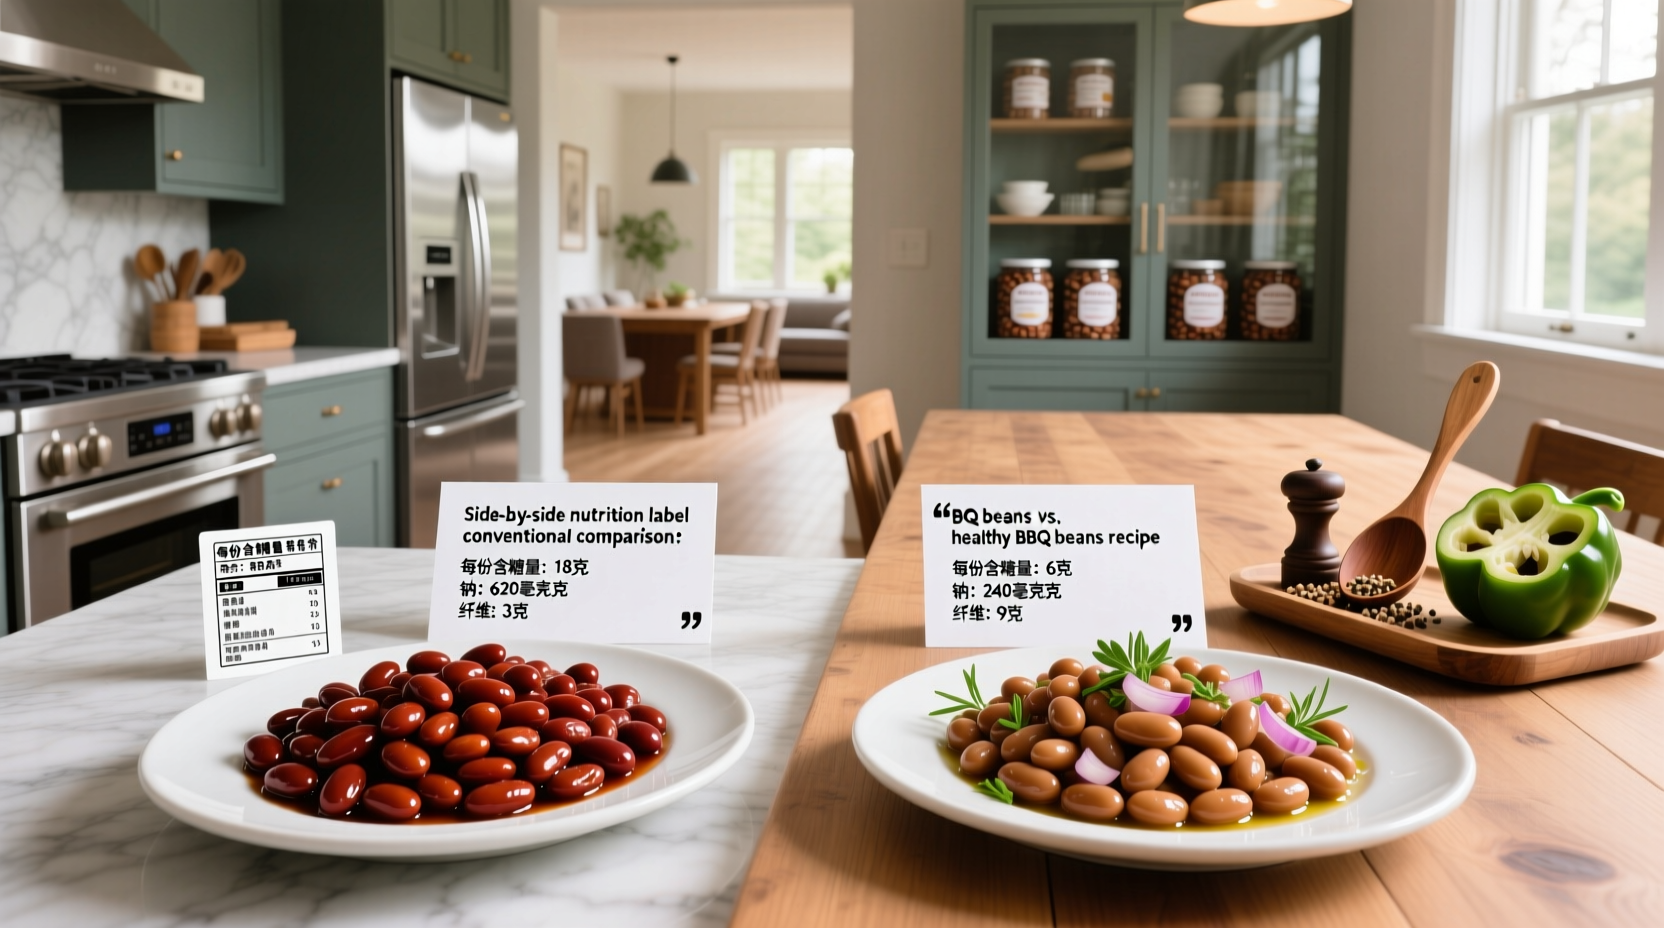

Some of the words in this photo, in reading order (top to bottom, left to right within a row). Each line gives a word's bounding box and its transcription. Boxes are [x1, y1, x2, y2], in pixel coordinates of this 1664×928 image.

[465, 506, 566, 526] Side-by-side
[570, 506, 644, 522] nutrition
[649, 506, 689, 522] label
[983, 508, 1032, 524] beans
[463, 529, 572, 544] conventional
[577, 528, 682, 548] comparison:
[952, 529, 1011, 549] healthy
[1016, 530, 1052, 547] BBQ
[1055, 529, 1104, 544] beans
[1109, 529, 1161, 549] recipe
